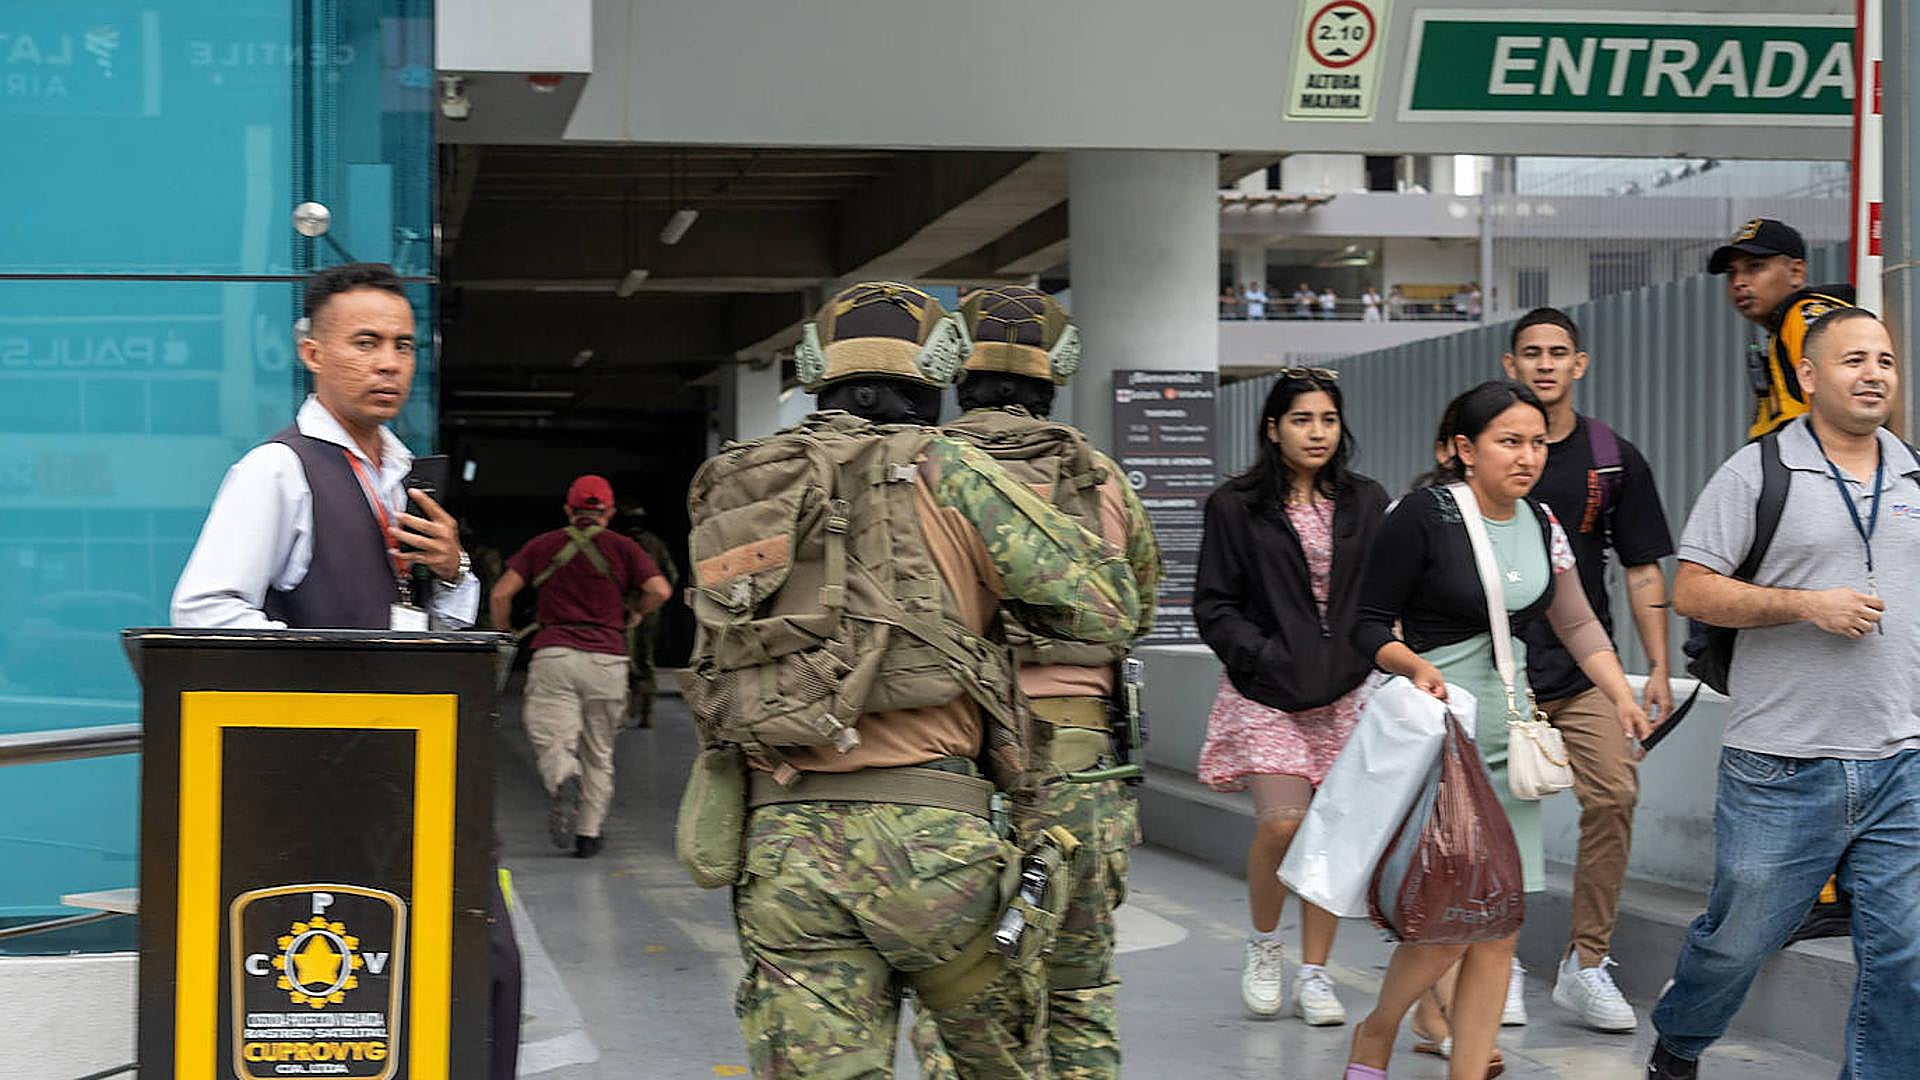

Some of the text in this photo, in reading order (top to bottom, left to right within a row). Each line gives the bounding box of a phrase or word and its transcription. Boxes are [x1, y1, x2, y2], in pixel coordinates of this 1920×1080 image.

[1318, 25, 1364, 40] 2.10
[1488, 36, 1857, 99] ENTRADA
[1306, 74, 1361, 88] ALTURA
[1300, 94, 1361, 108] MAXIMA
[312, 893, 334, 914] P
[245, 952, 389, 975] C V
[244, 1041, 387, 1062] CUPROVYG
